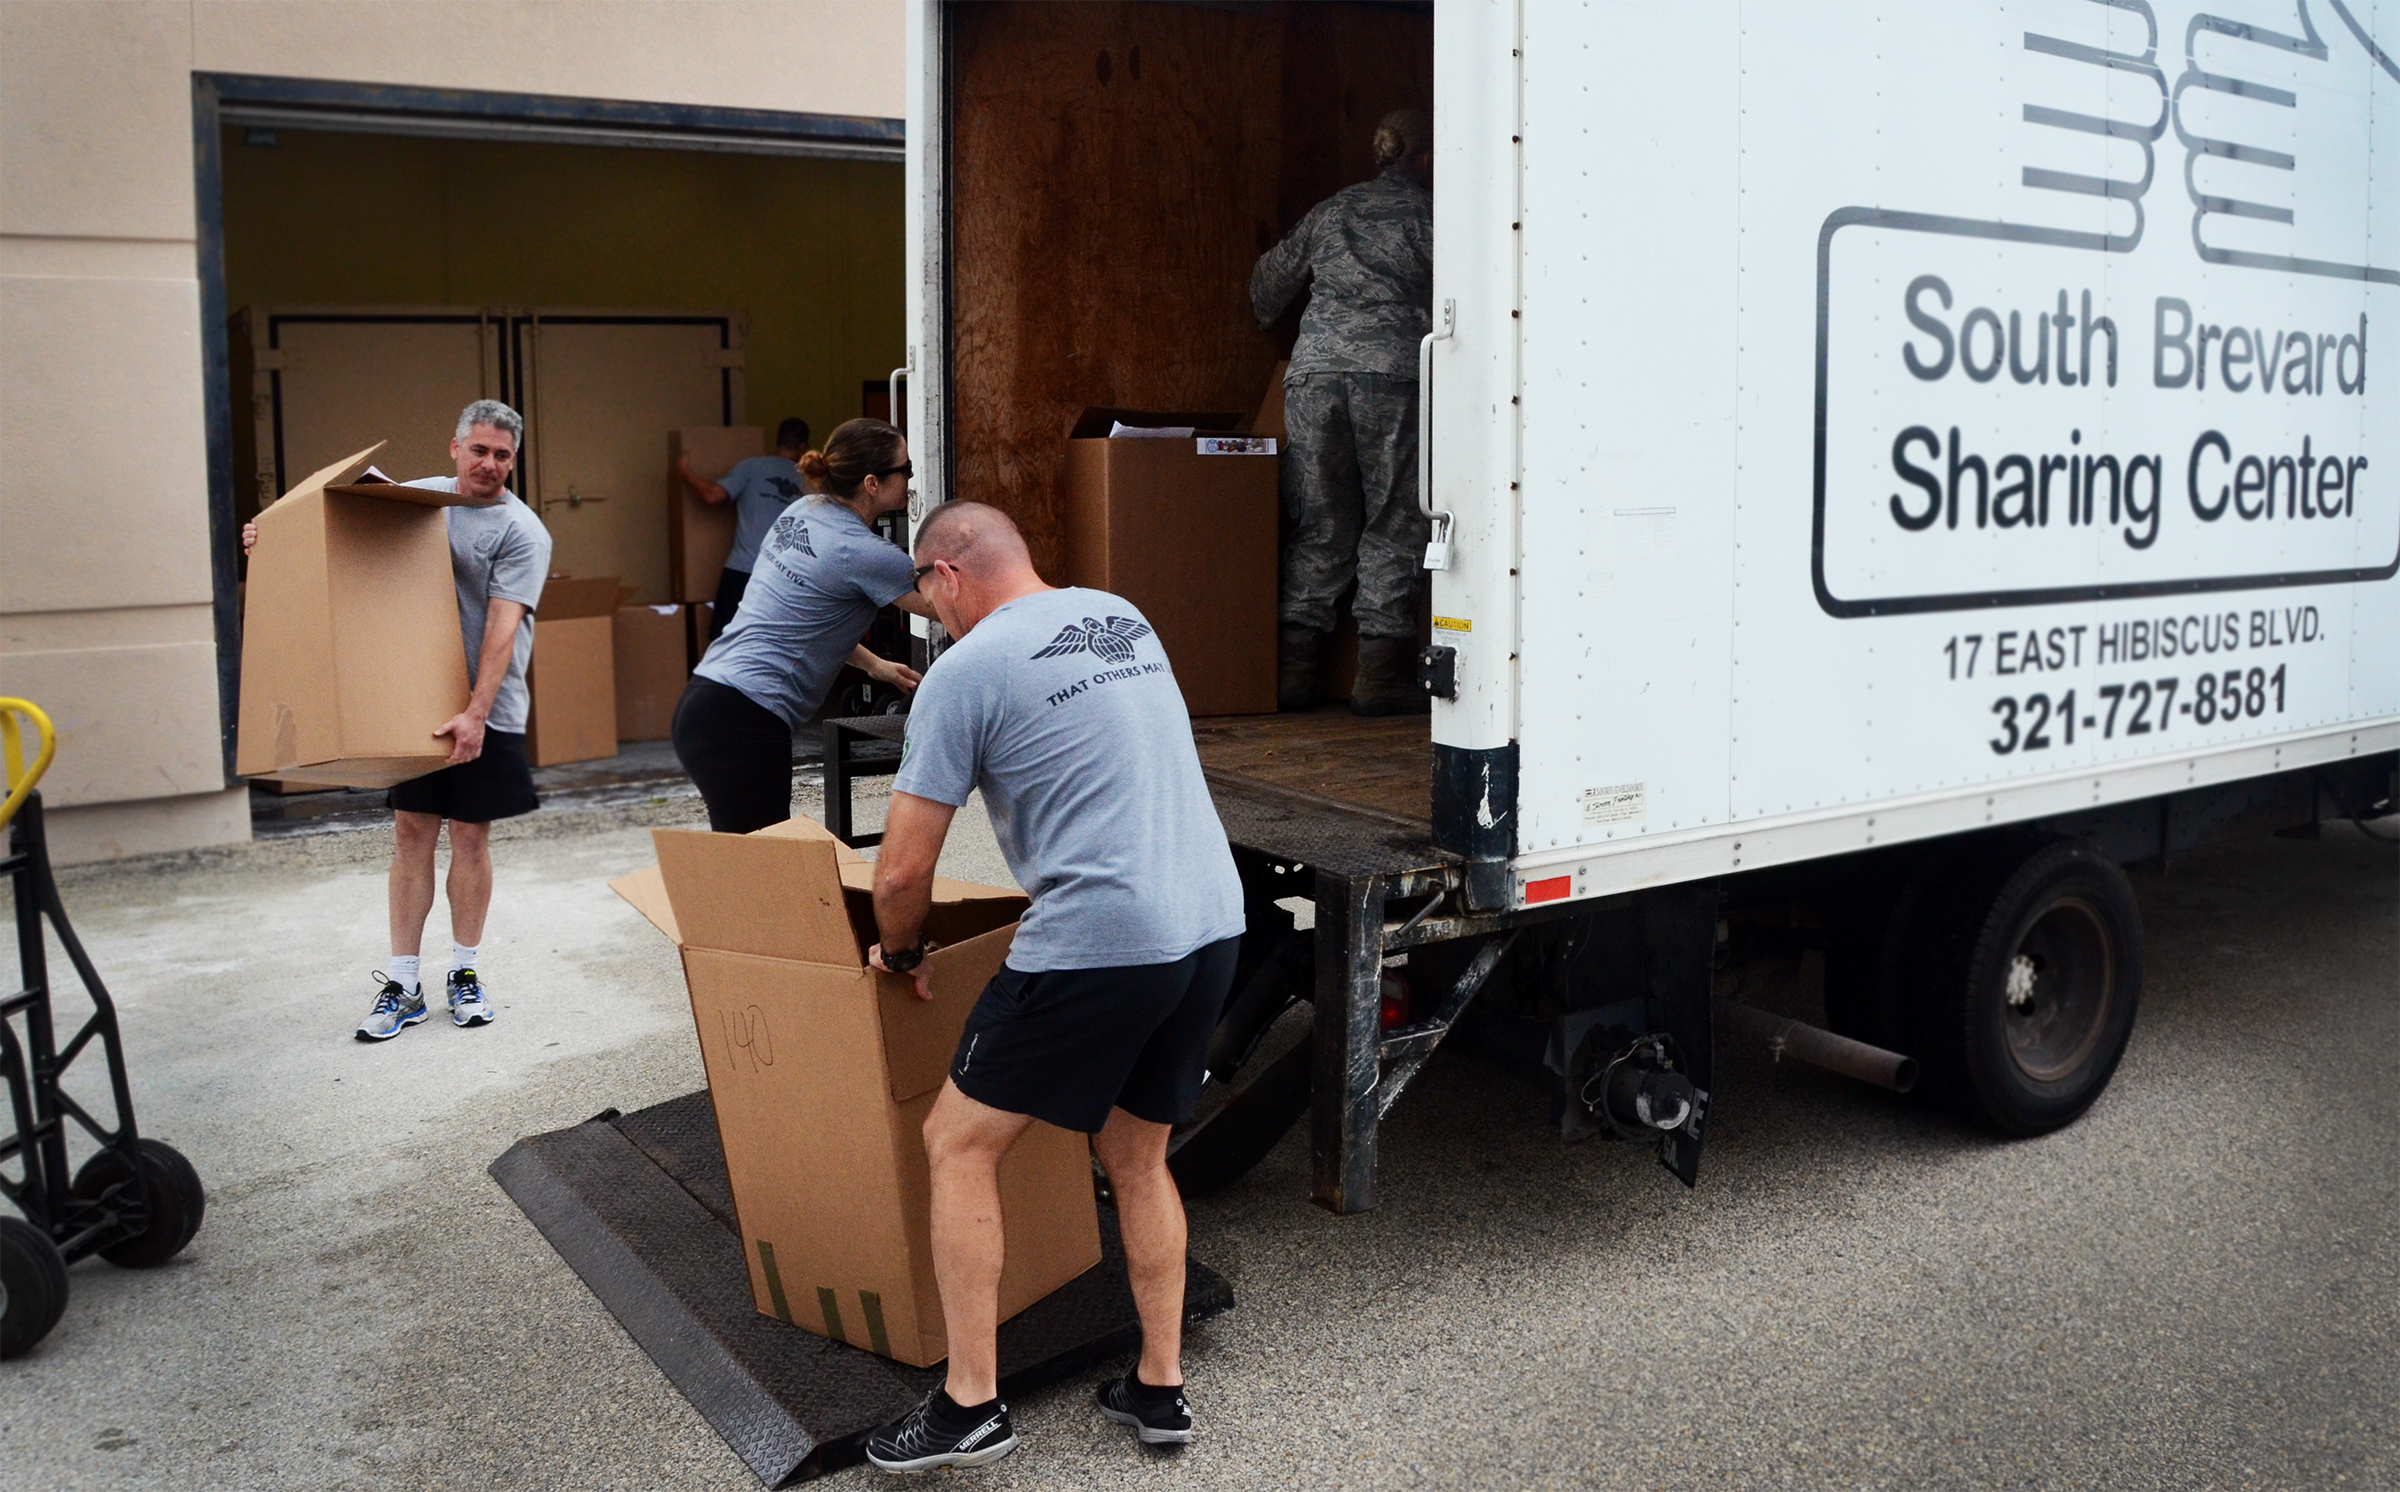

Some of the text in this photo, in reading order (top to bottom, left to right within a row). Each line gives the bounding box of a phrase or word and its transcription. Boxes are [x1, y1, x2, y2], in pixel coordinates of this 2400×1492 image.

[1902, 274, 2368, 396] South Brevard
[1889, 425, 2368, 550] Sharing Center
[786, 570, 806, 587] LIVE
[1440, 618, 1469, 629] CAUTION
[1943, 605, 2325, 680] 17 EAST HIBISCUS BLVD.
[1046, 662, 1166, 707] THAT OTHERS MAY
[1989, 663, 2288, 756] 321-727-8581
[719, 1005, 773, 1073] 140
[959, 1421, 999, 1450] MERRELL
